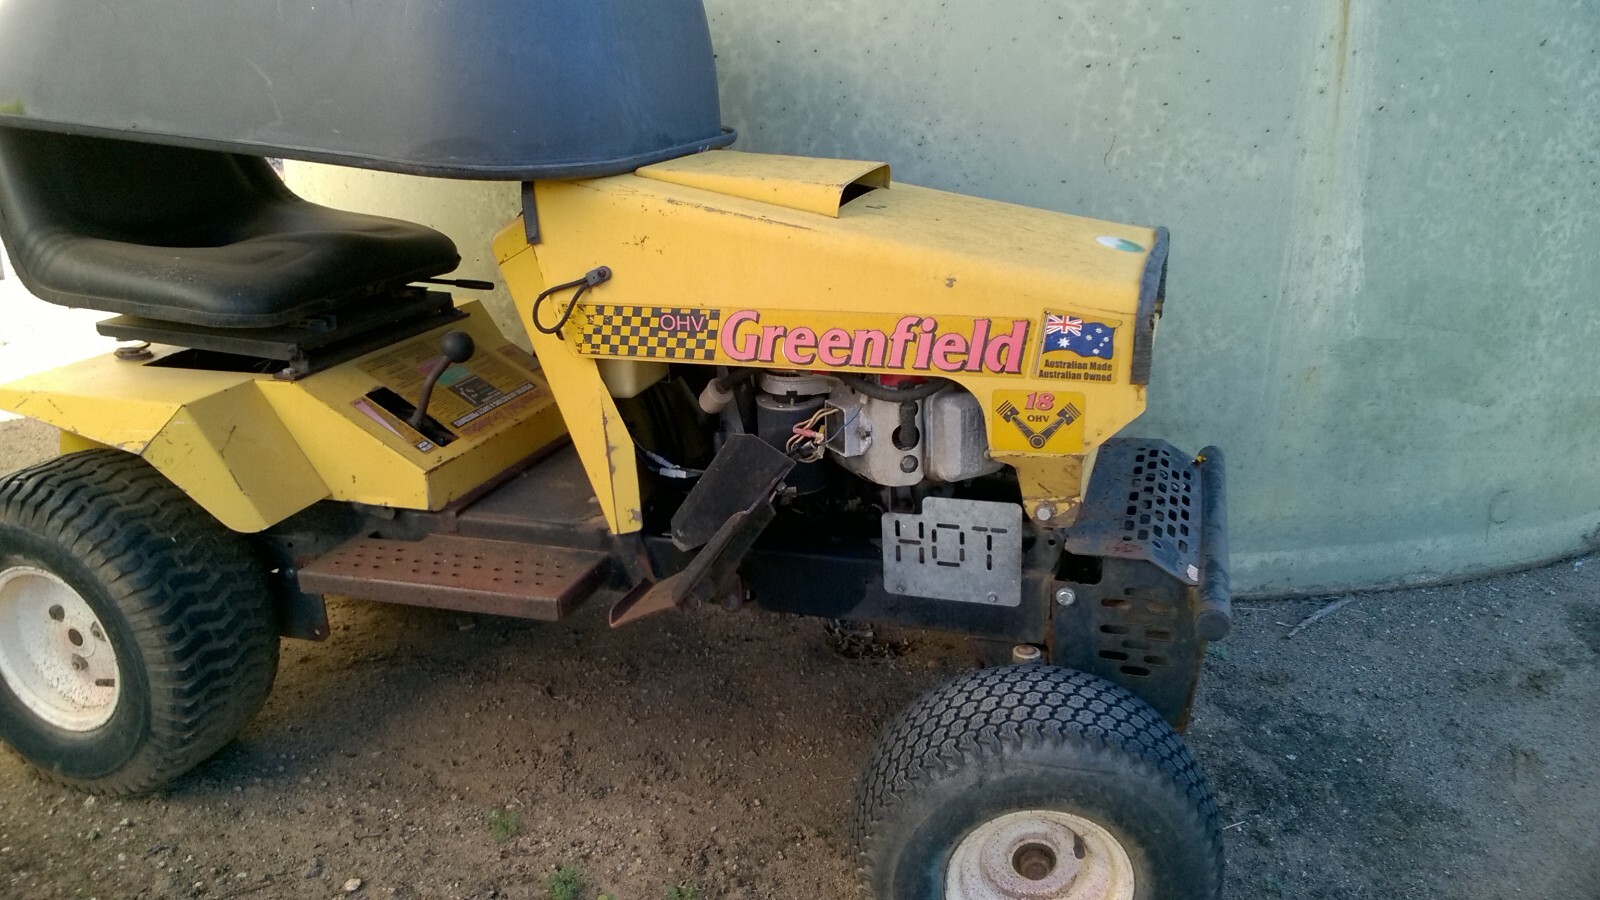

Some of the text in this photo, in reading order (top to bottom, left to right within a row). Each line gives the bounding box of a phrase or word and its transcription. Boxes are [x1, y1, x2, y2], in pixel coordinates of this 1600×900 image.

[660, 314, 704, 332] OHV
[720, 309, 1029, 375] Greenfield
[1044, 359, 1113, 371] Australian Made
[1038, 369, 1112, 382] Australian Owned
[1025, 392, 1055, 411] 18
[1027, 414, 1050, 423] OHV
[894, 519, 1008, 571] HOT
